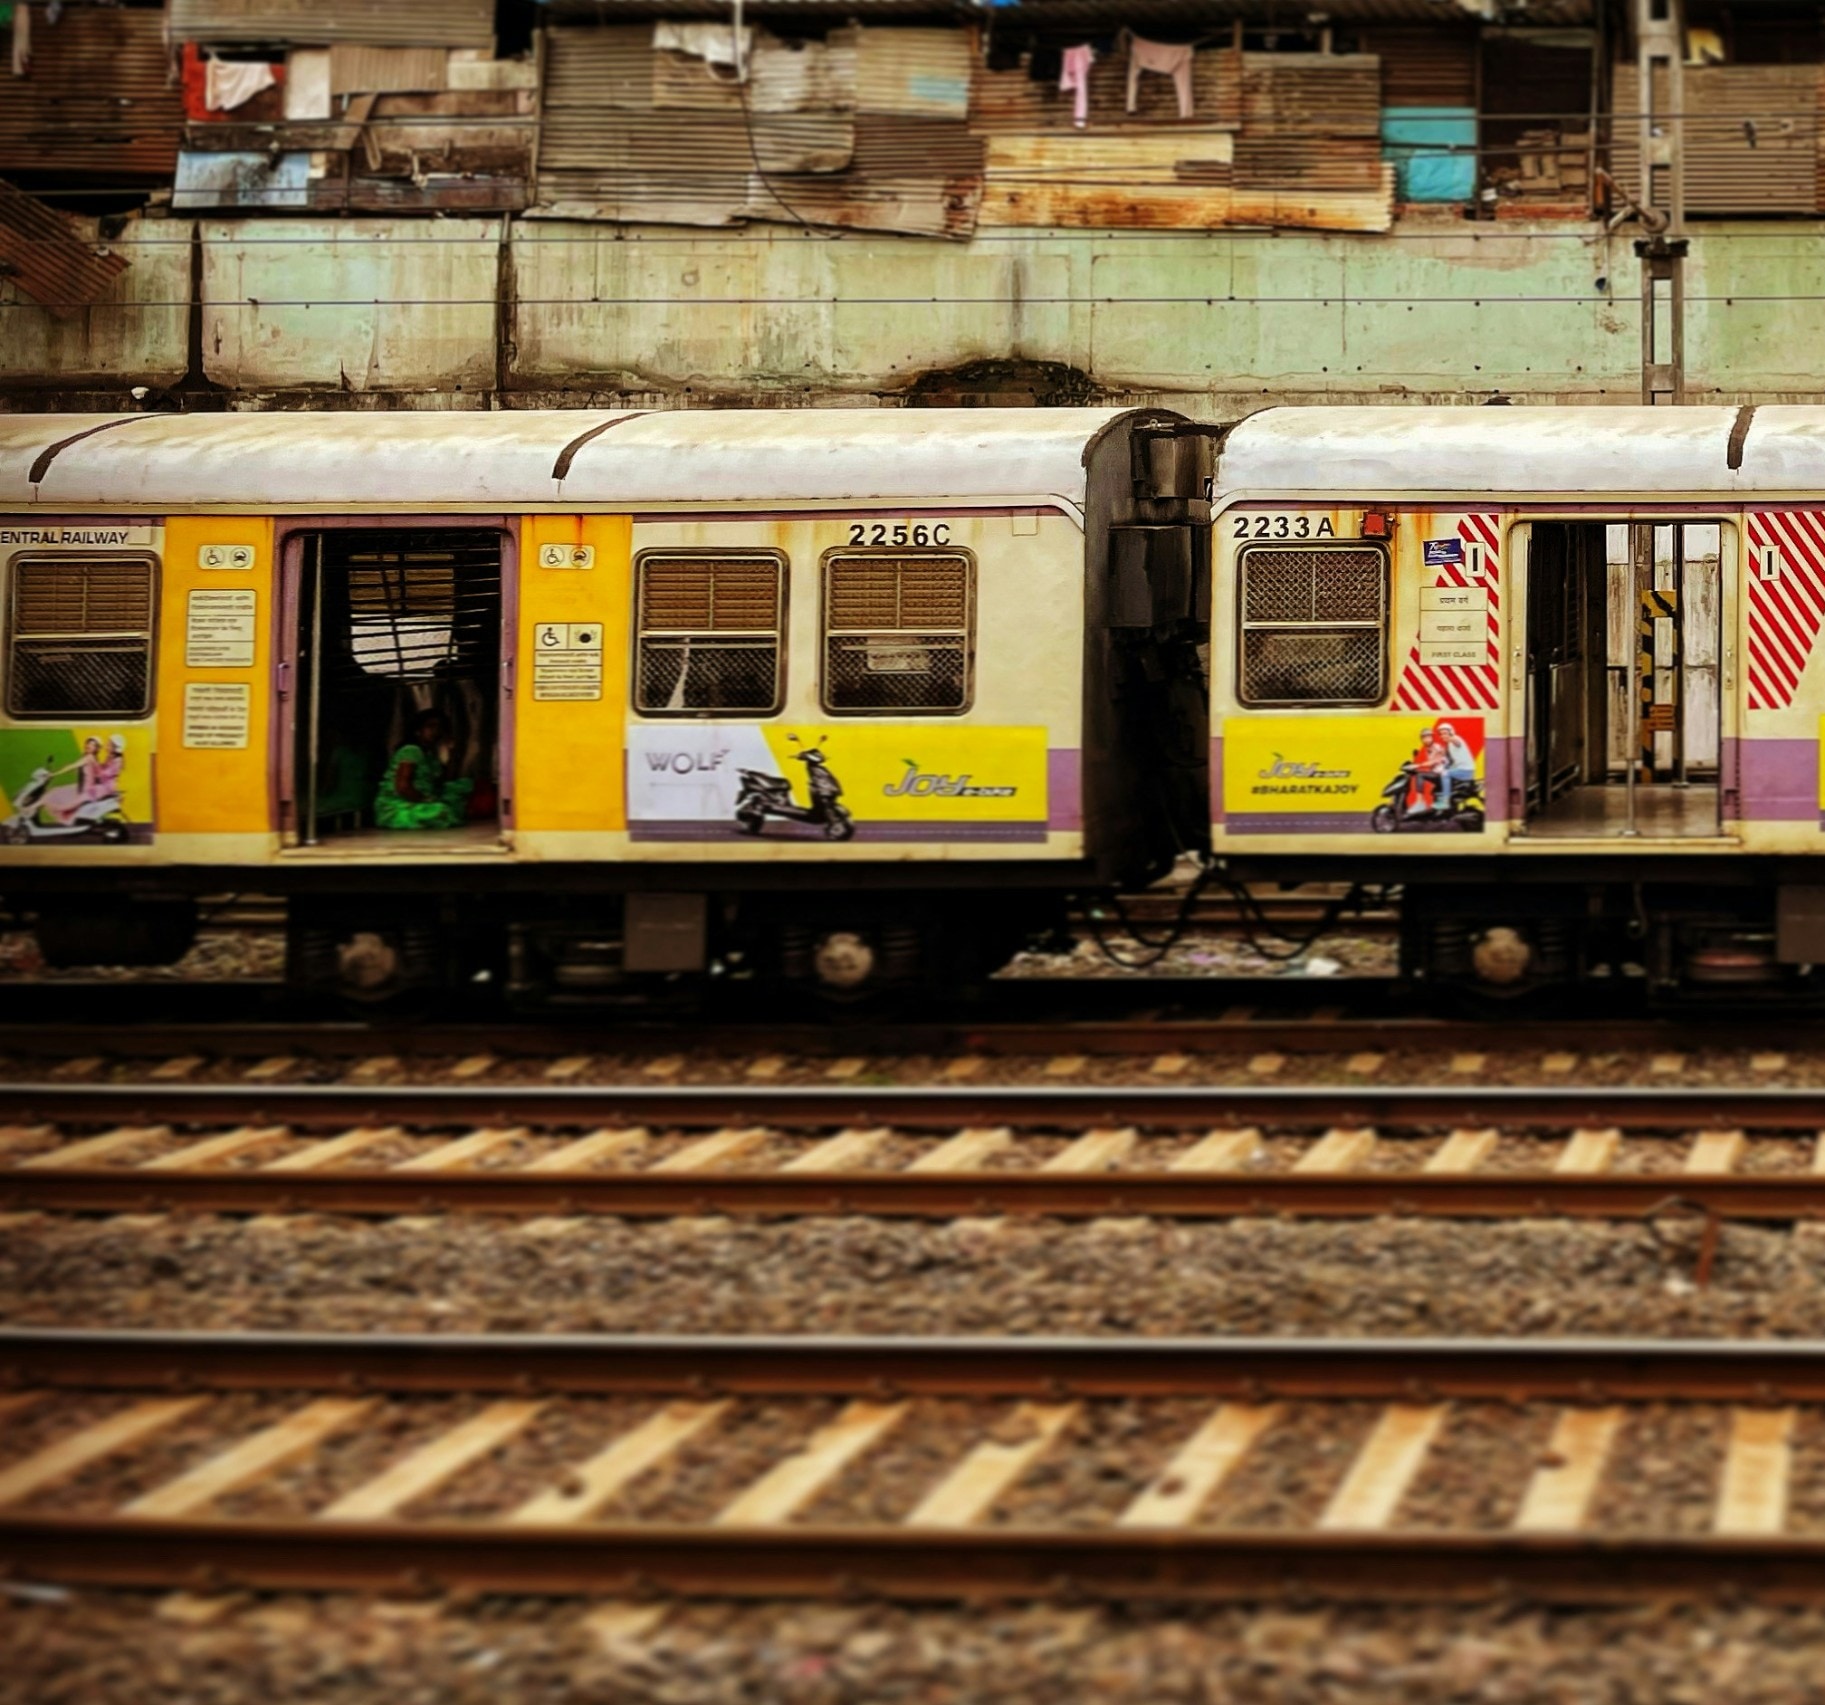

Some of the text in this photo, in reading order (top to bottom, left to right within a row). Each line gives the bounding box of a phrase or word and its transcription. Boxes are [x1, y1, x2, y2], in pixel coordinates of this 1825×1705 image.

[0, 531, 129, 544] ENTRAL RAILWAY
[849, 524, 950, 546] 2256C
[1233, 516, 1335, 538] 2233A
